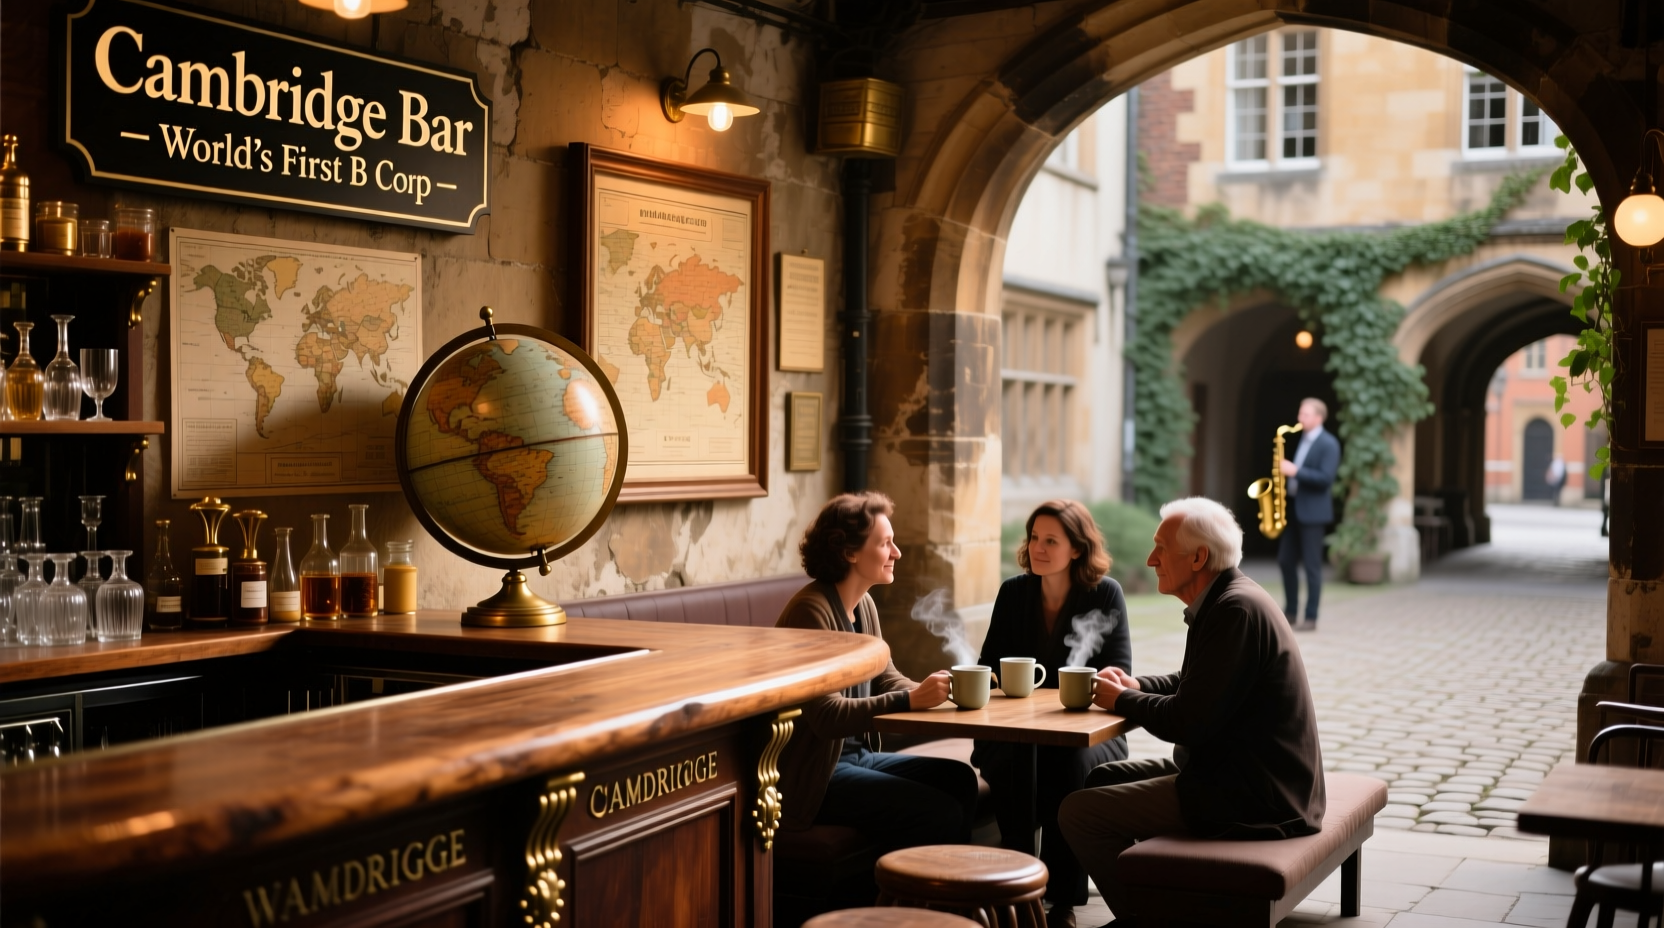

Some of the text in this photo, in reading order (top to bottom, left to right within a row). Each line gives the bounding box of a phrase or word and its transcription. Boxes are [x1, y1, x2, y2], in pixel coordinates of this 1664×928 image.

[95, 25, 474, 156] Cambridge Bar
[158, 123, 432, 206] World’s First B Corp
